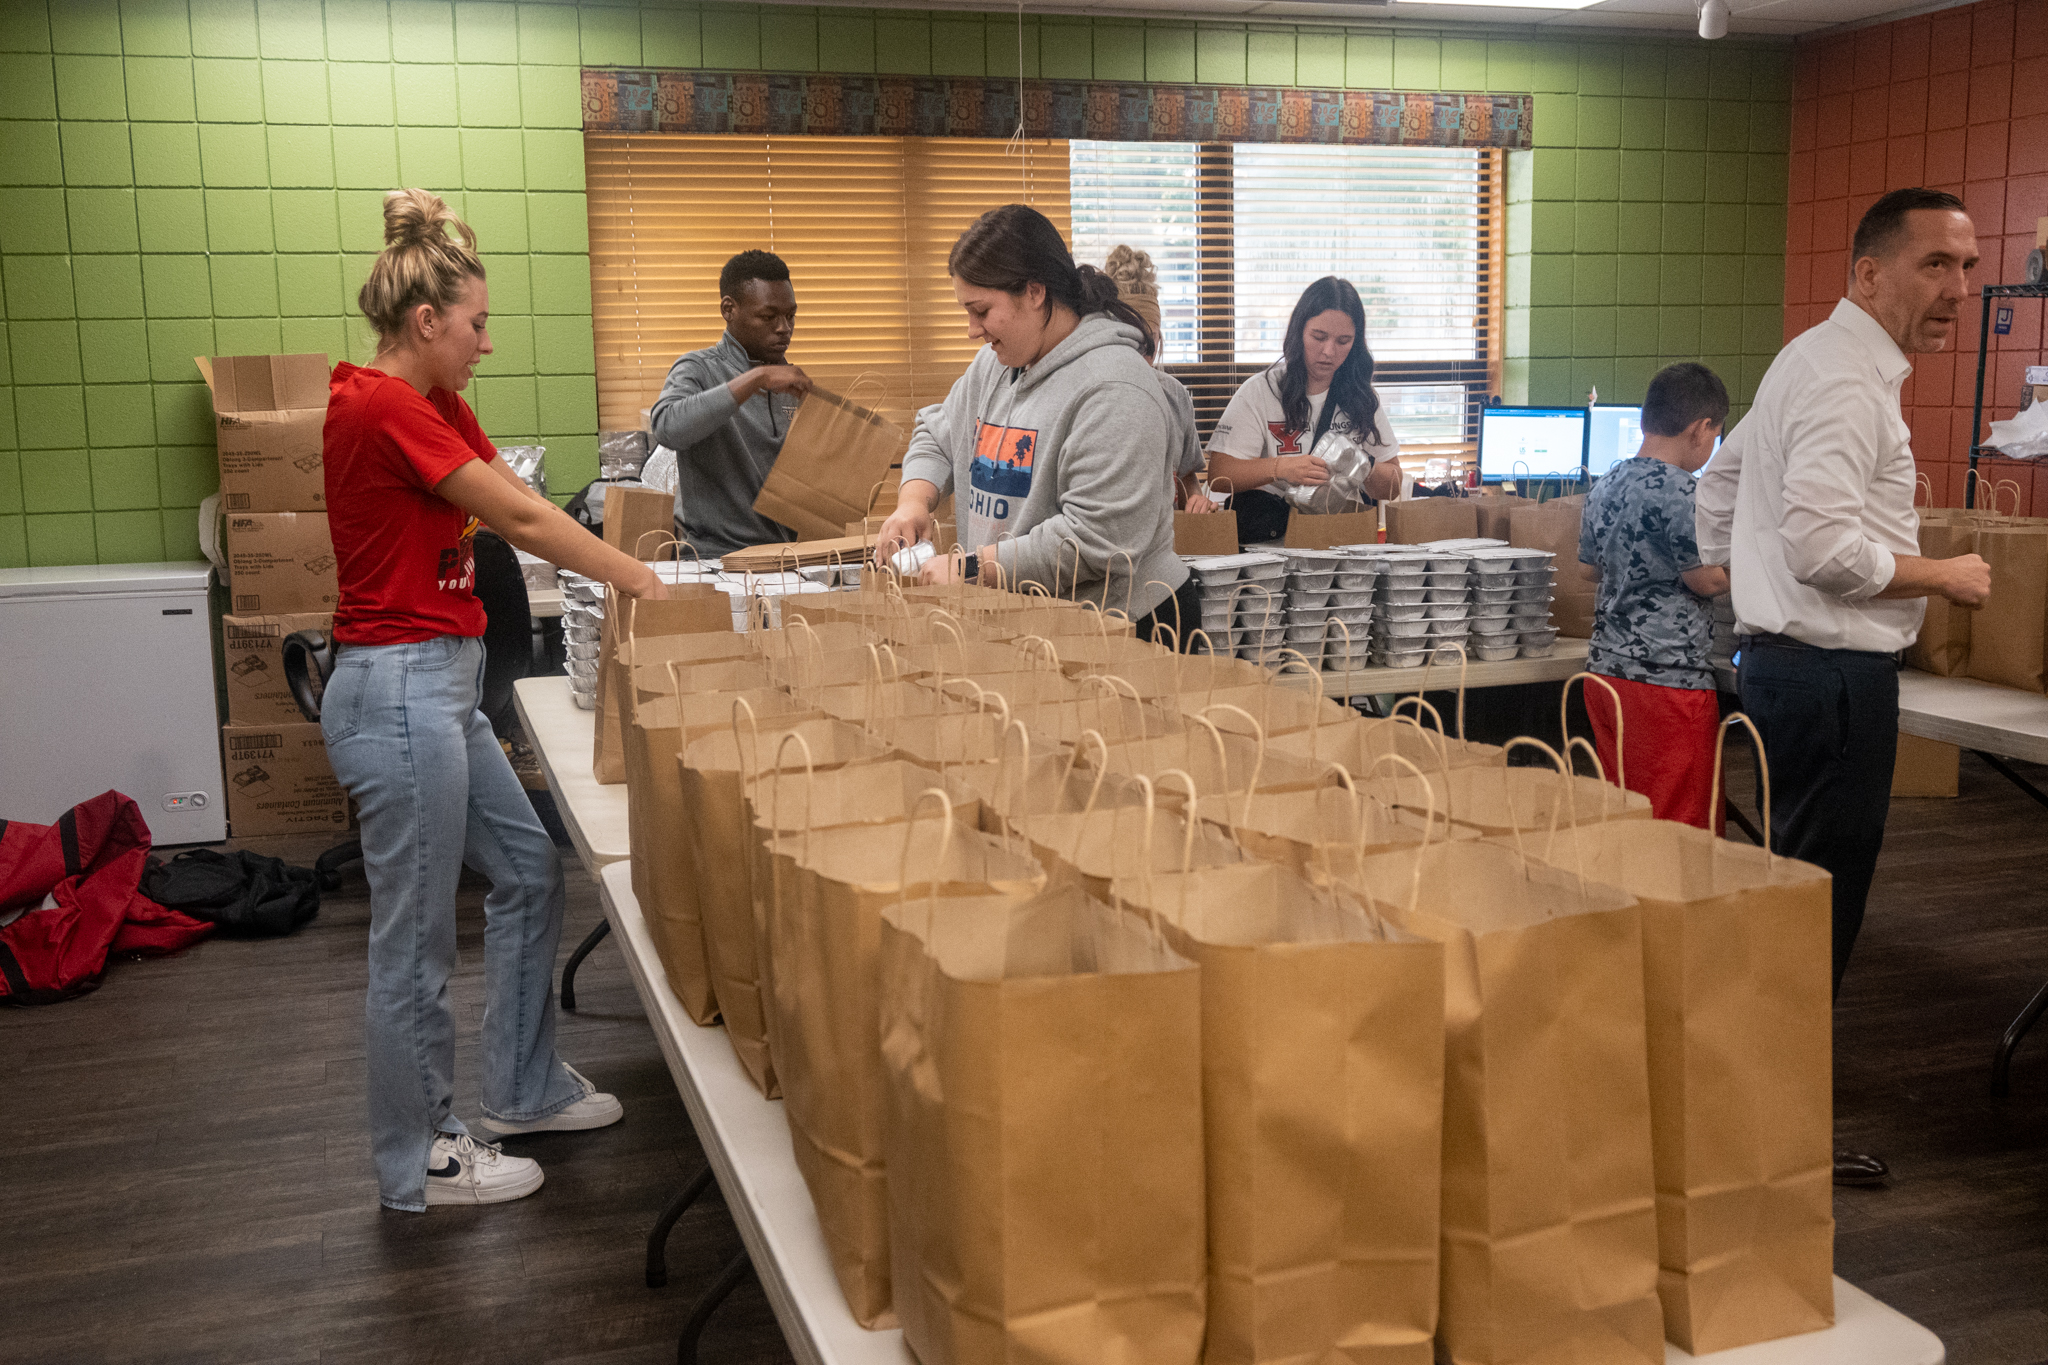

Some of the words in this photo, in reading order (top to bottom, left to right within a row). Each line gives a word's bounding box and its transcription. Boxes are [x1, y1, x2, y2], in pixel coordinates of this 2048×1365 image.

[1267, 421, 1311, 455] Y
[232, 519, 252, 527] HFA
[229, 639, 273, 650] Y7139TP
[254, 690, 294, 700] ontainers
[231, 749, 275, 761] Y7139TP
[256, 800, 300, 810] Containers
[302, 797, 345, 808] Aluminum
[285, 814, 329, 823] PACTIV
